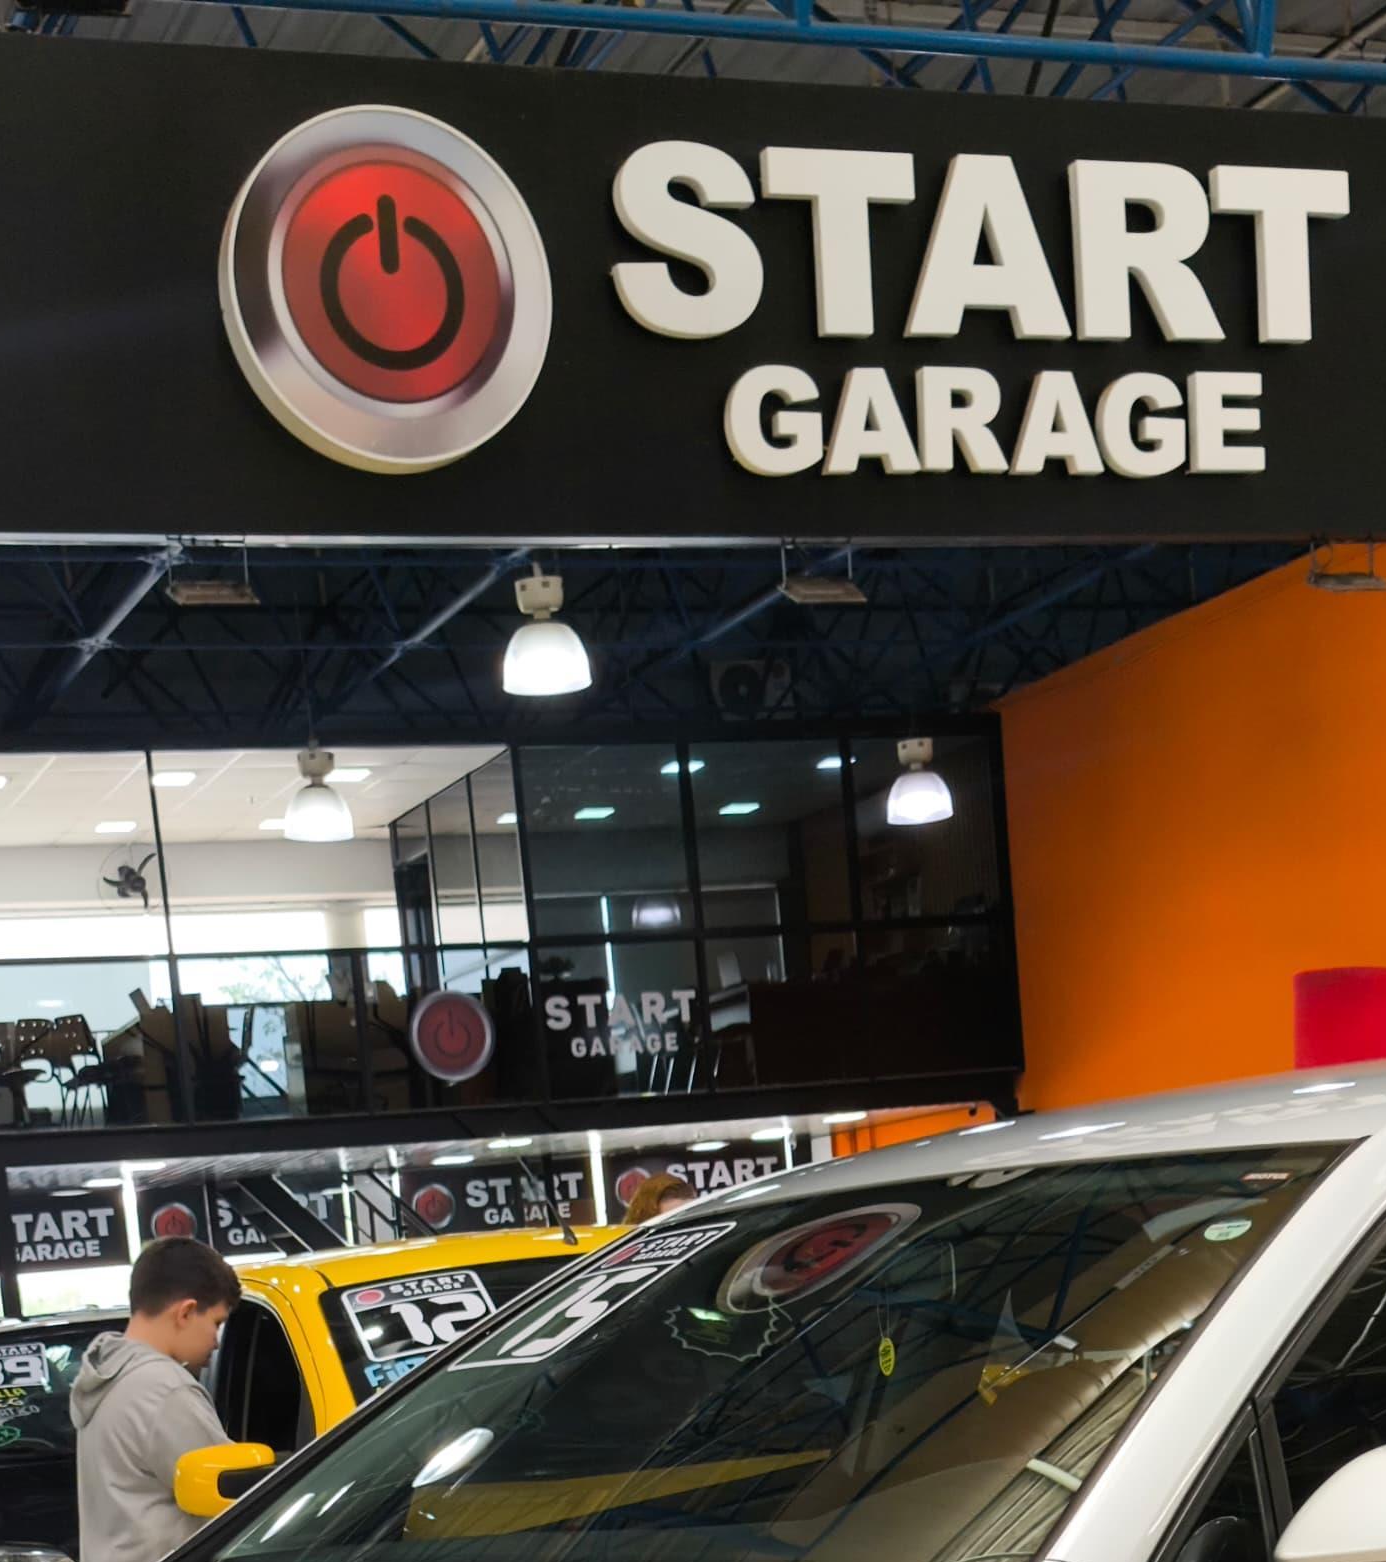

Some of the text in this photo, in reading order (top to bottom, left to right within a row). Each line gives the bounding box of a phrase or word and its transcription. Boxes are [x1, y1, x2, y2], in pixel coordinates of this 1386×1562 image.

[611, 140, 1350, 343] START
[724, 364, 1265, 477] GARAGE
[545, 990, 696, 1030] START
[570, 1032, 679, 1058] GARAGE
[15, 1240, 101, 1262] ARAGE
[389, 1274, 466, 1293] START
